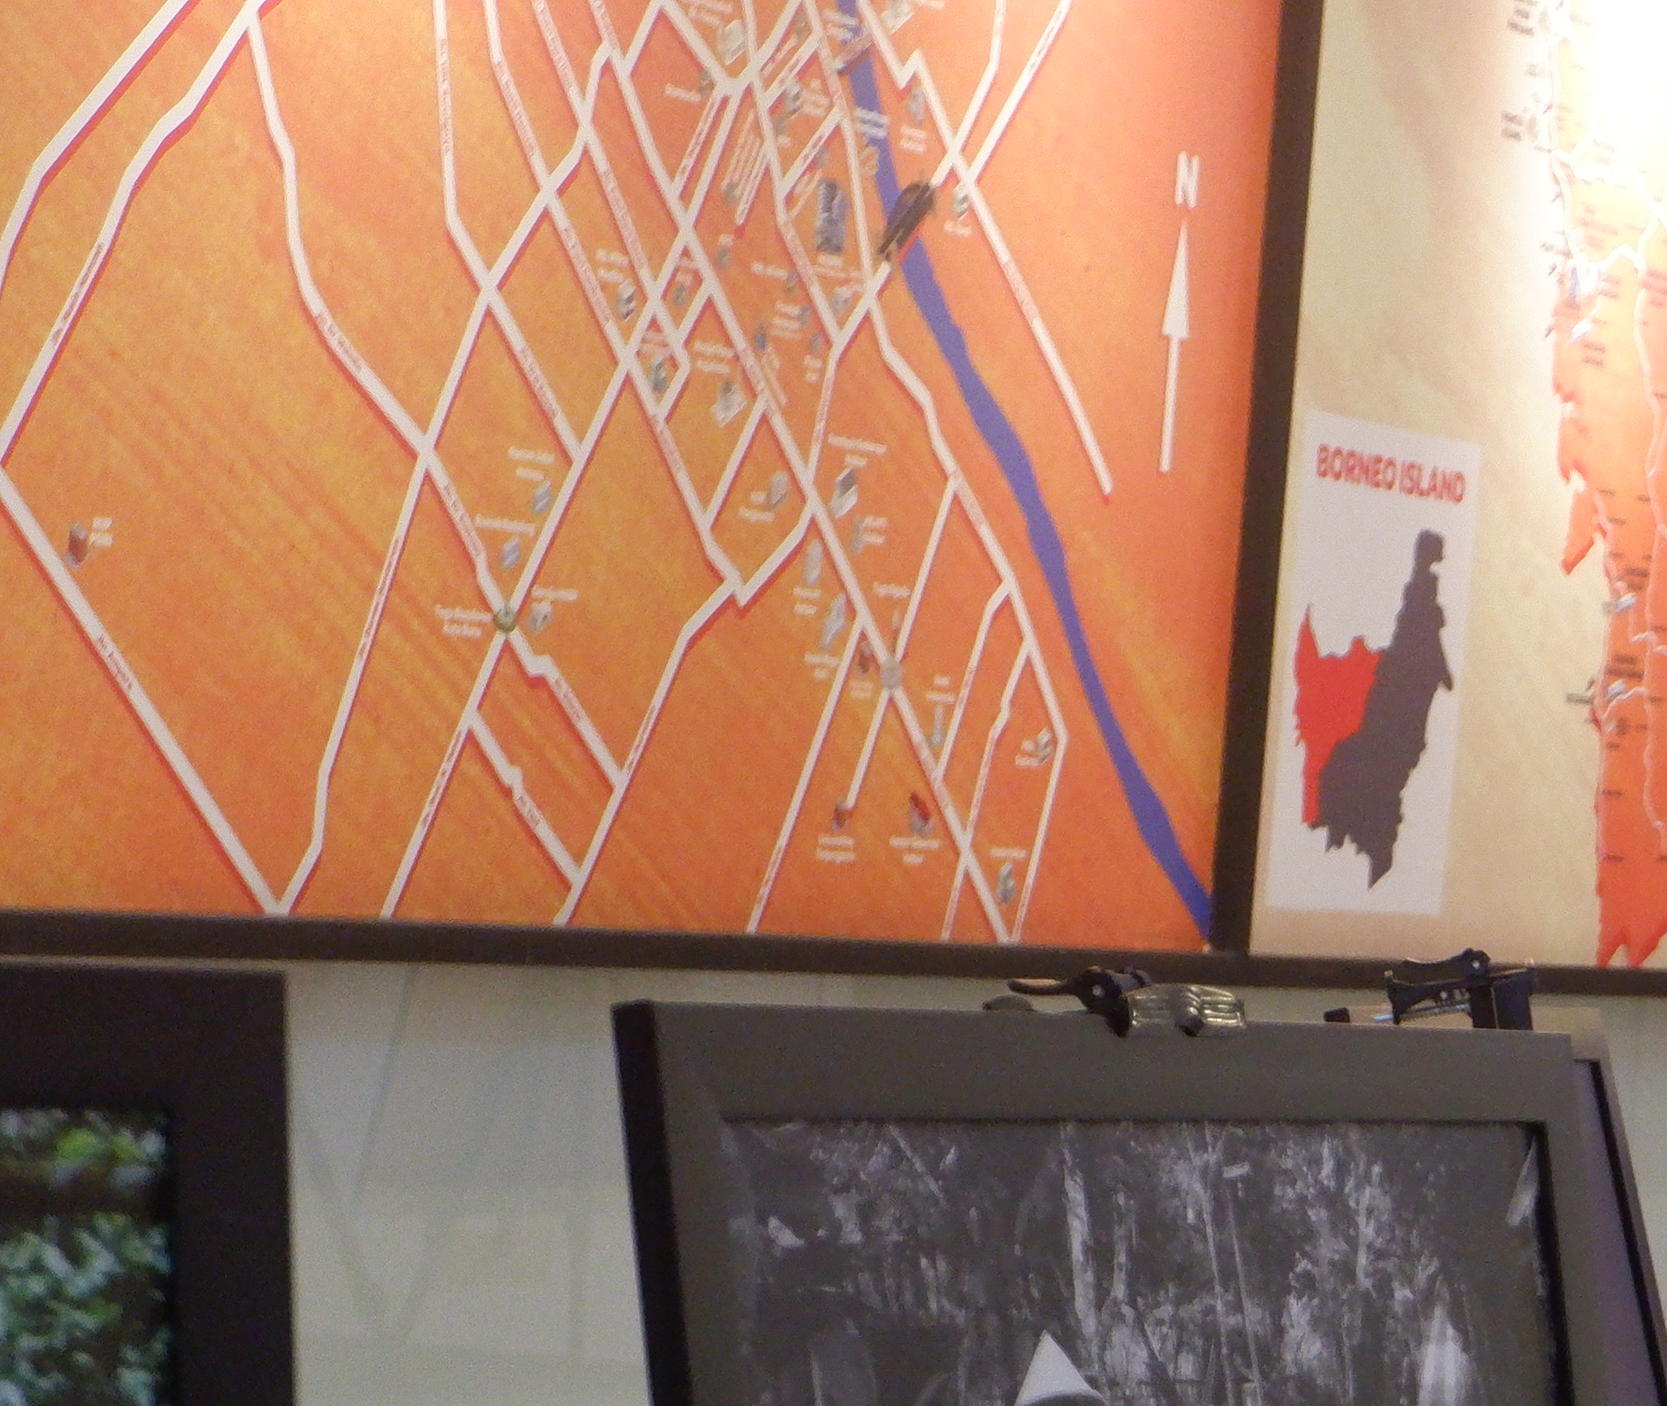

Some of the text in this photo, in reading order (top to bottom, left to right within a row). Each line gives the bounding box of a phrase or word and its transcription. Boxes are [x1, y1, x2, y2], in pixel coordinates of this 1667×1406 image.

[1174, 150, 1201, 209] N
[1316, 443, 1467, 504] BORNEO ISLAND
